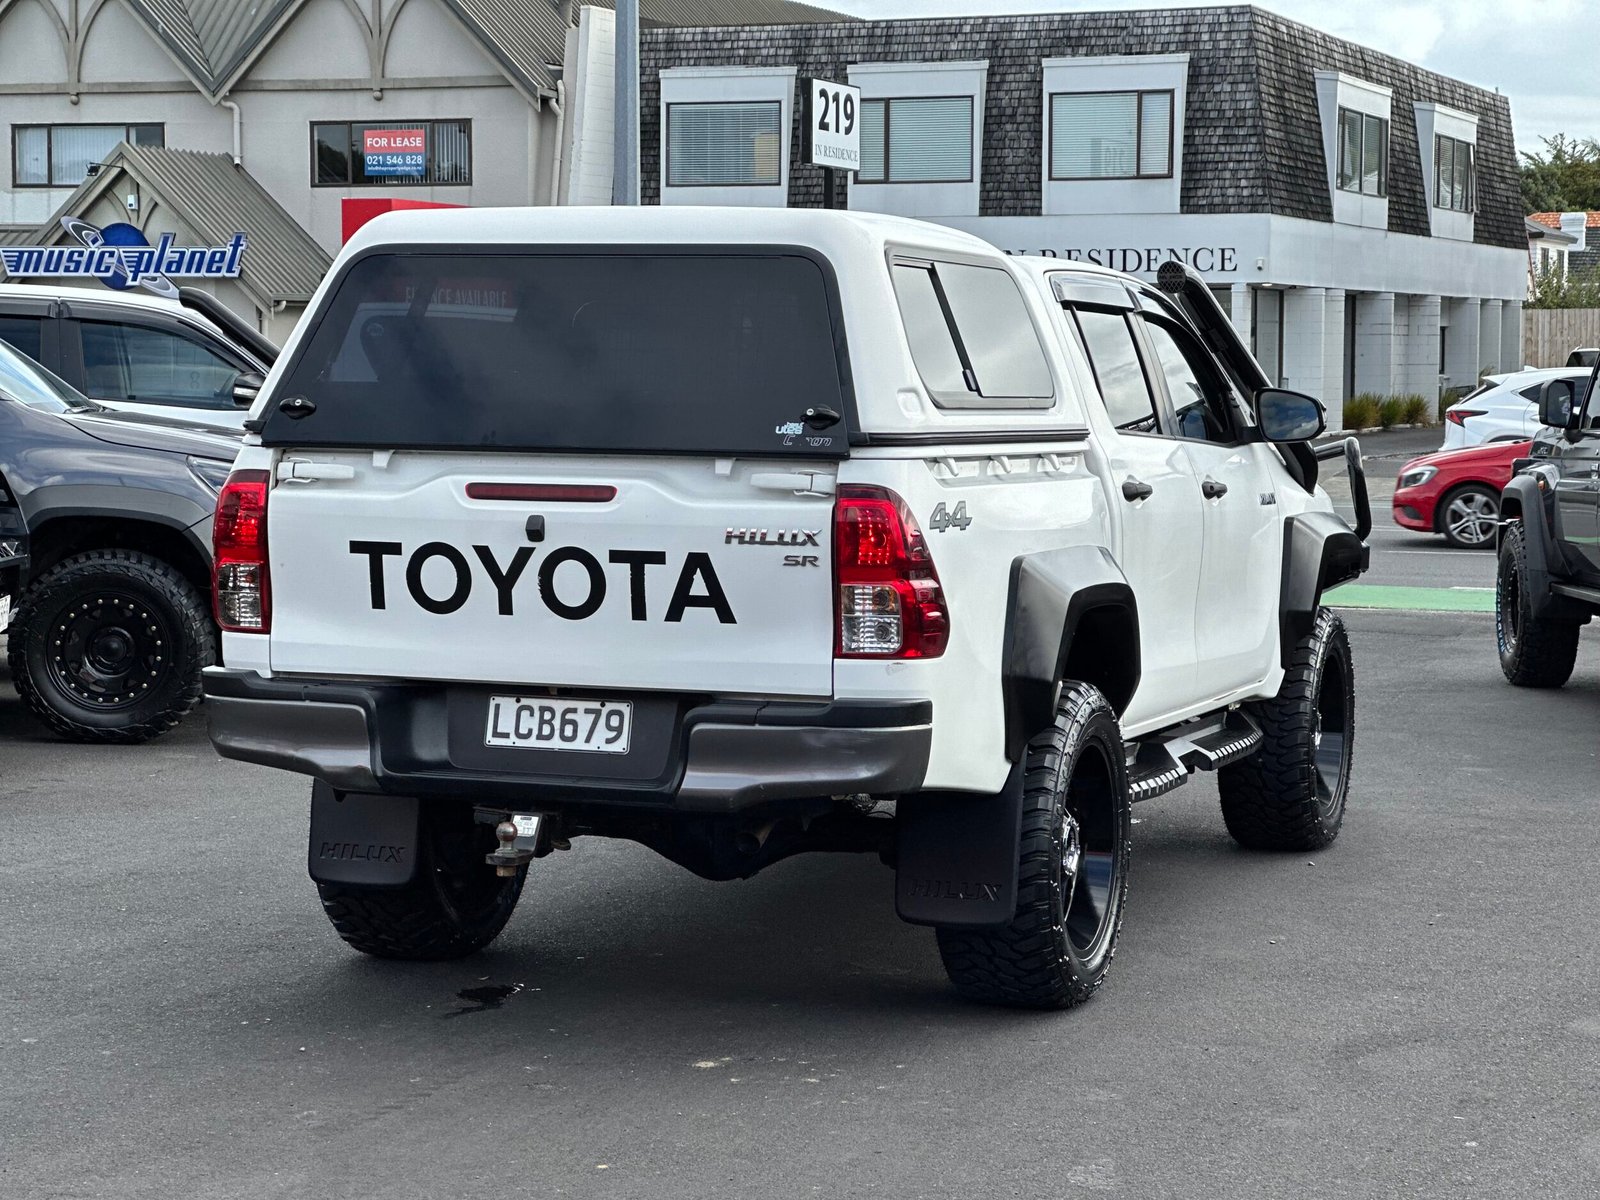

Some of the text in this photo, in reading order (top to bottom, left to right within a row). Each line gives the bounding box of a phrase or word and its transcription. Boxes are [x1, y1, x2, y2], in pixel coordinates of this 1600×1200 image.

[818, 87, 855, 136] 219
[366, 136, 423, 148] FOR LEASE
[814, 143, 859, 162] IN RESIDENCE
[366, 155, 423, 165] 021 546 828
[3, 232, 248, 286] music planet
[929, 500, 973, 533] 4x4
[724, 527, 822, 547] HILUX
[782, 554, 820, 568] SR
[348, 539, 738, 625] TOYOTA
[491, 703, 625, 745] LCB679
[320, 842, 406, 863] HILUX
[904, 879, 1003, 902] HILUX
